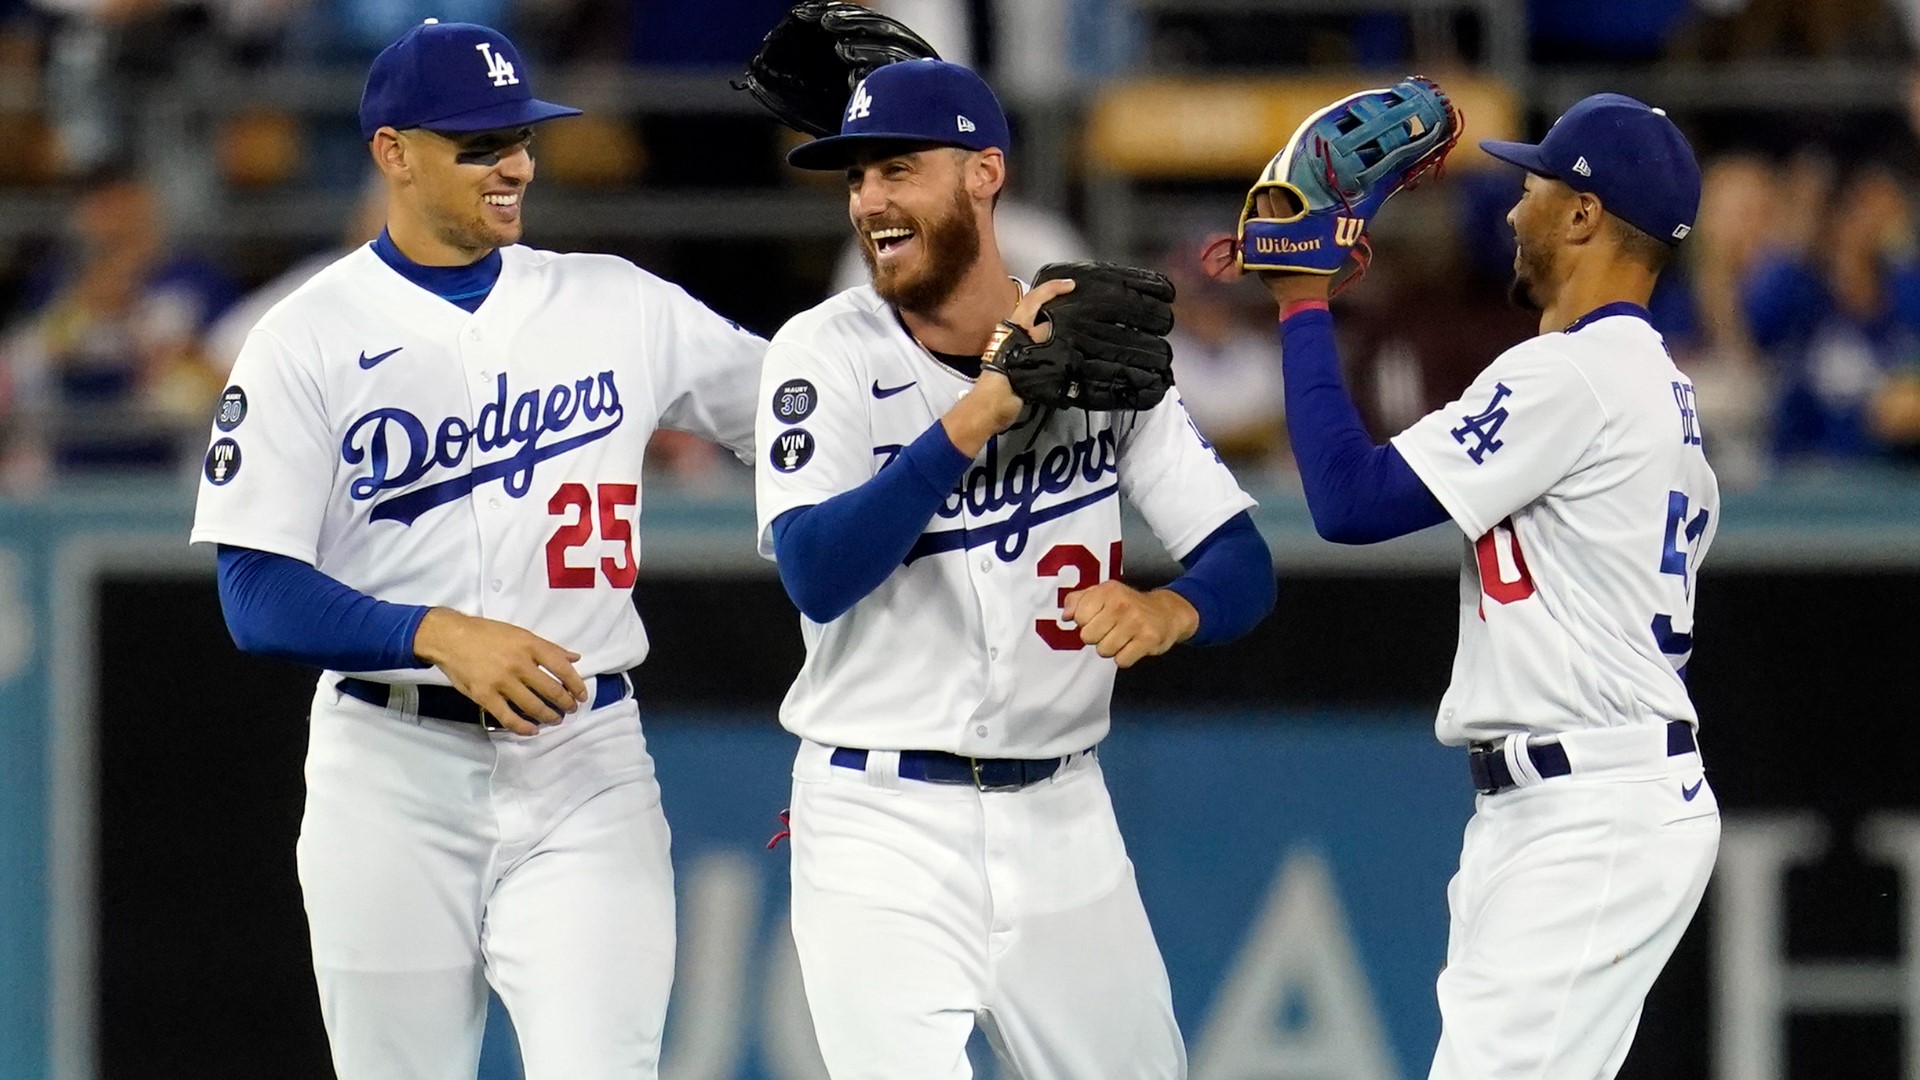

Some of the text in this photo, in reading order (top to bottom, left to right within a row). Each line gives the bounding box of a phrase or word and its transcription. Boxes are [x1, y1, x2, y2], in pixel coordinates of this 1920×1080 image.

[475, 42, 520, 87] LA
[1256, 236, 1321, 253] Wilson
[220, 400, 242, 423] 30
[780, 393, 809, 416] 30
[1450, 382, 1512, 466] LA
[1671, 381, 1701, 446] BE
[215, 445, 234, 461] VIN
[342, 370, 623, 500] Dodgers
[781, 434, 805, 452] VIN
[874, 427, 1117, 563] odgers
[546, 483, 638, 588] 25
[1035, 540, 1122, 651] 3
